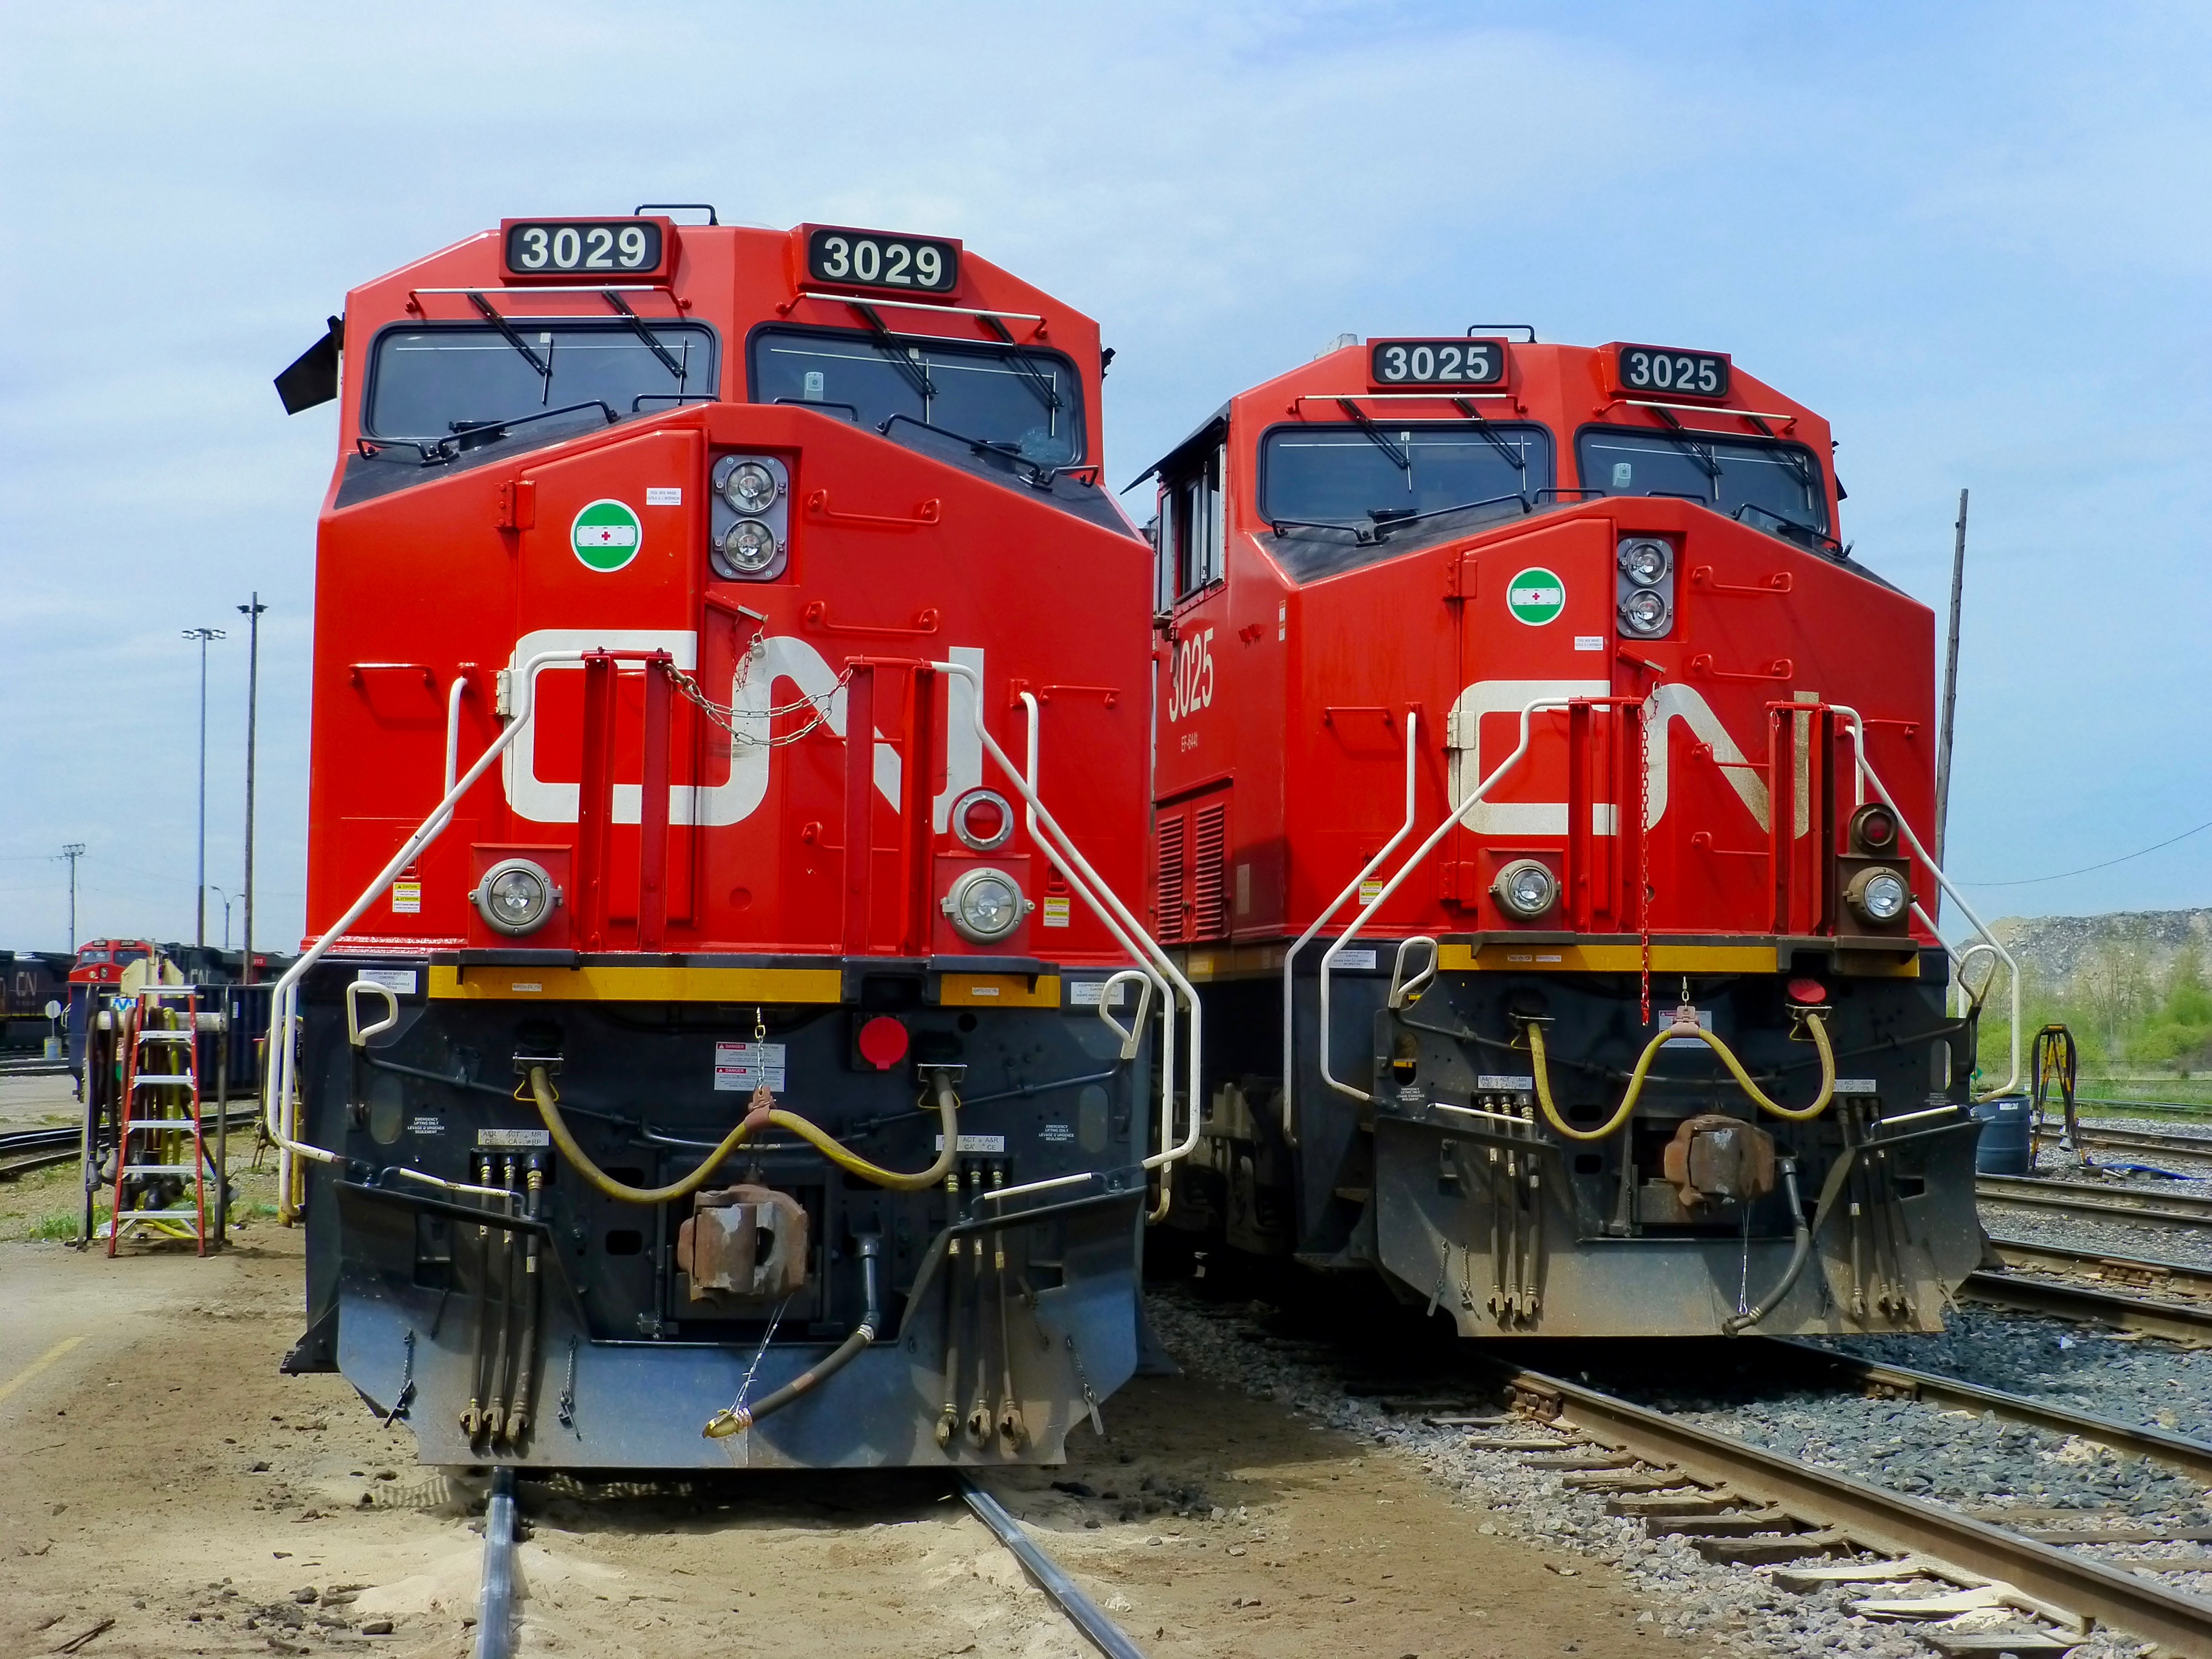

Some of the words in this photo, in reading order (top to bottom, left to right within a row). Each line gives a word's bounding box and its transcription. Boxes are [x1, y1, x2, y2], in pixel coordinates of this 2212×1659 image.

[521, 227, 647, 269] 3029
[823, 236, 942, 286] 3029
[1384, 346, 1489, 380] 3025
[1630, 352, 1717, 392] 3025
[1168, 627, 1214, 722] 3025
[503, 629, 984, 834] CN
[1448, 680, 1819, 839] CN
[16, 971, 37, 997] CN
